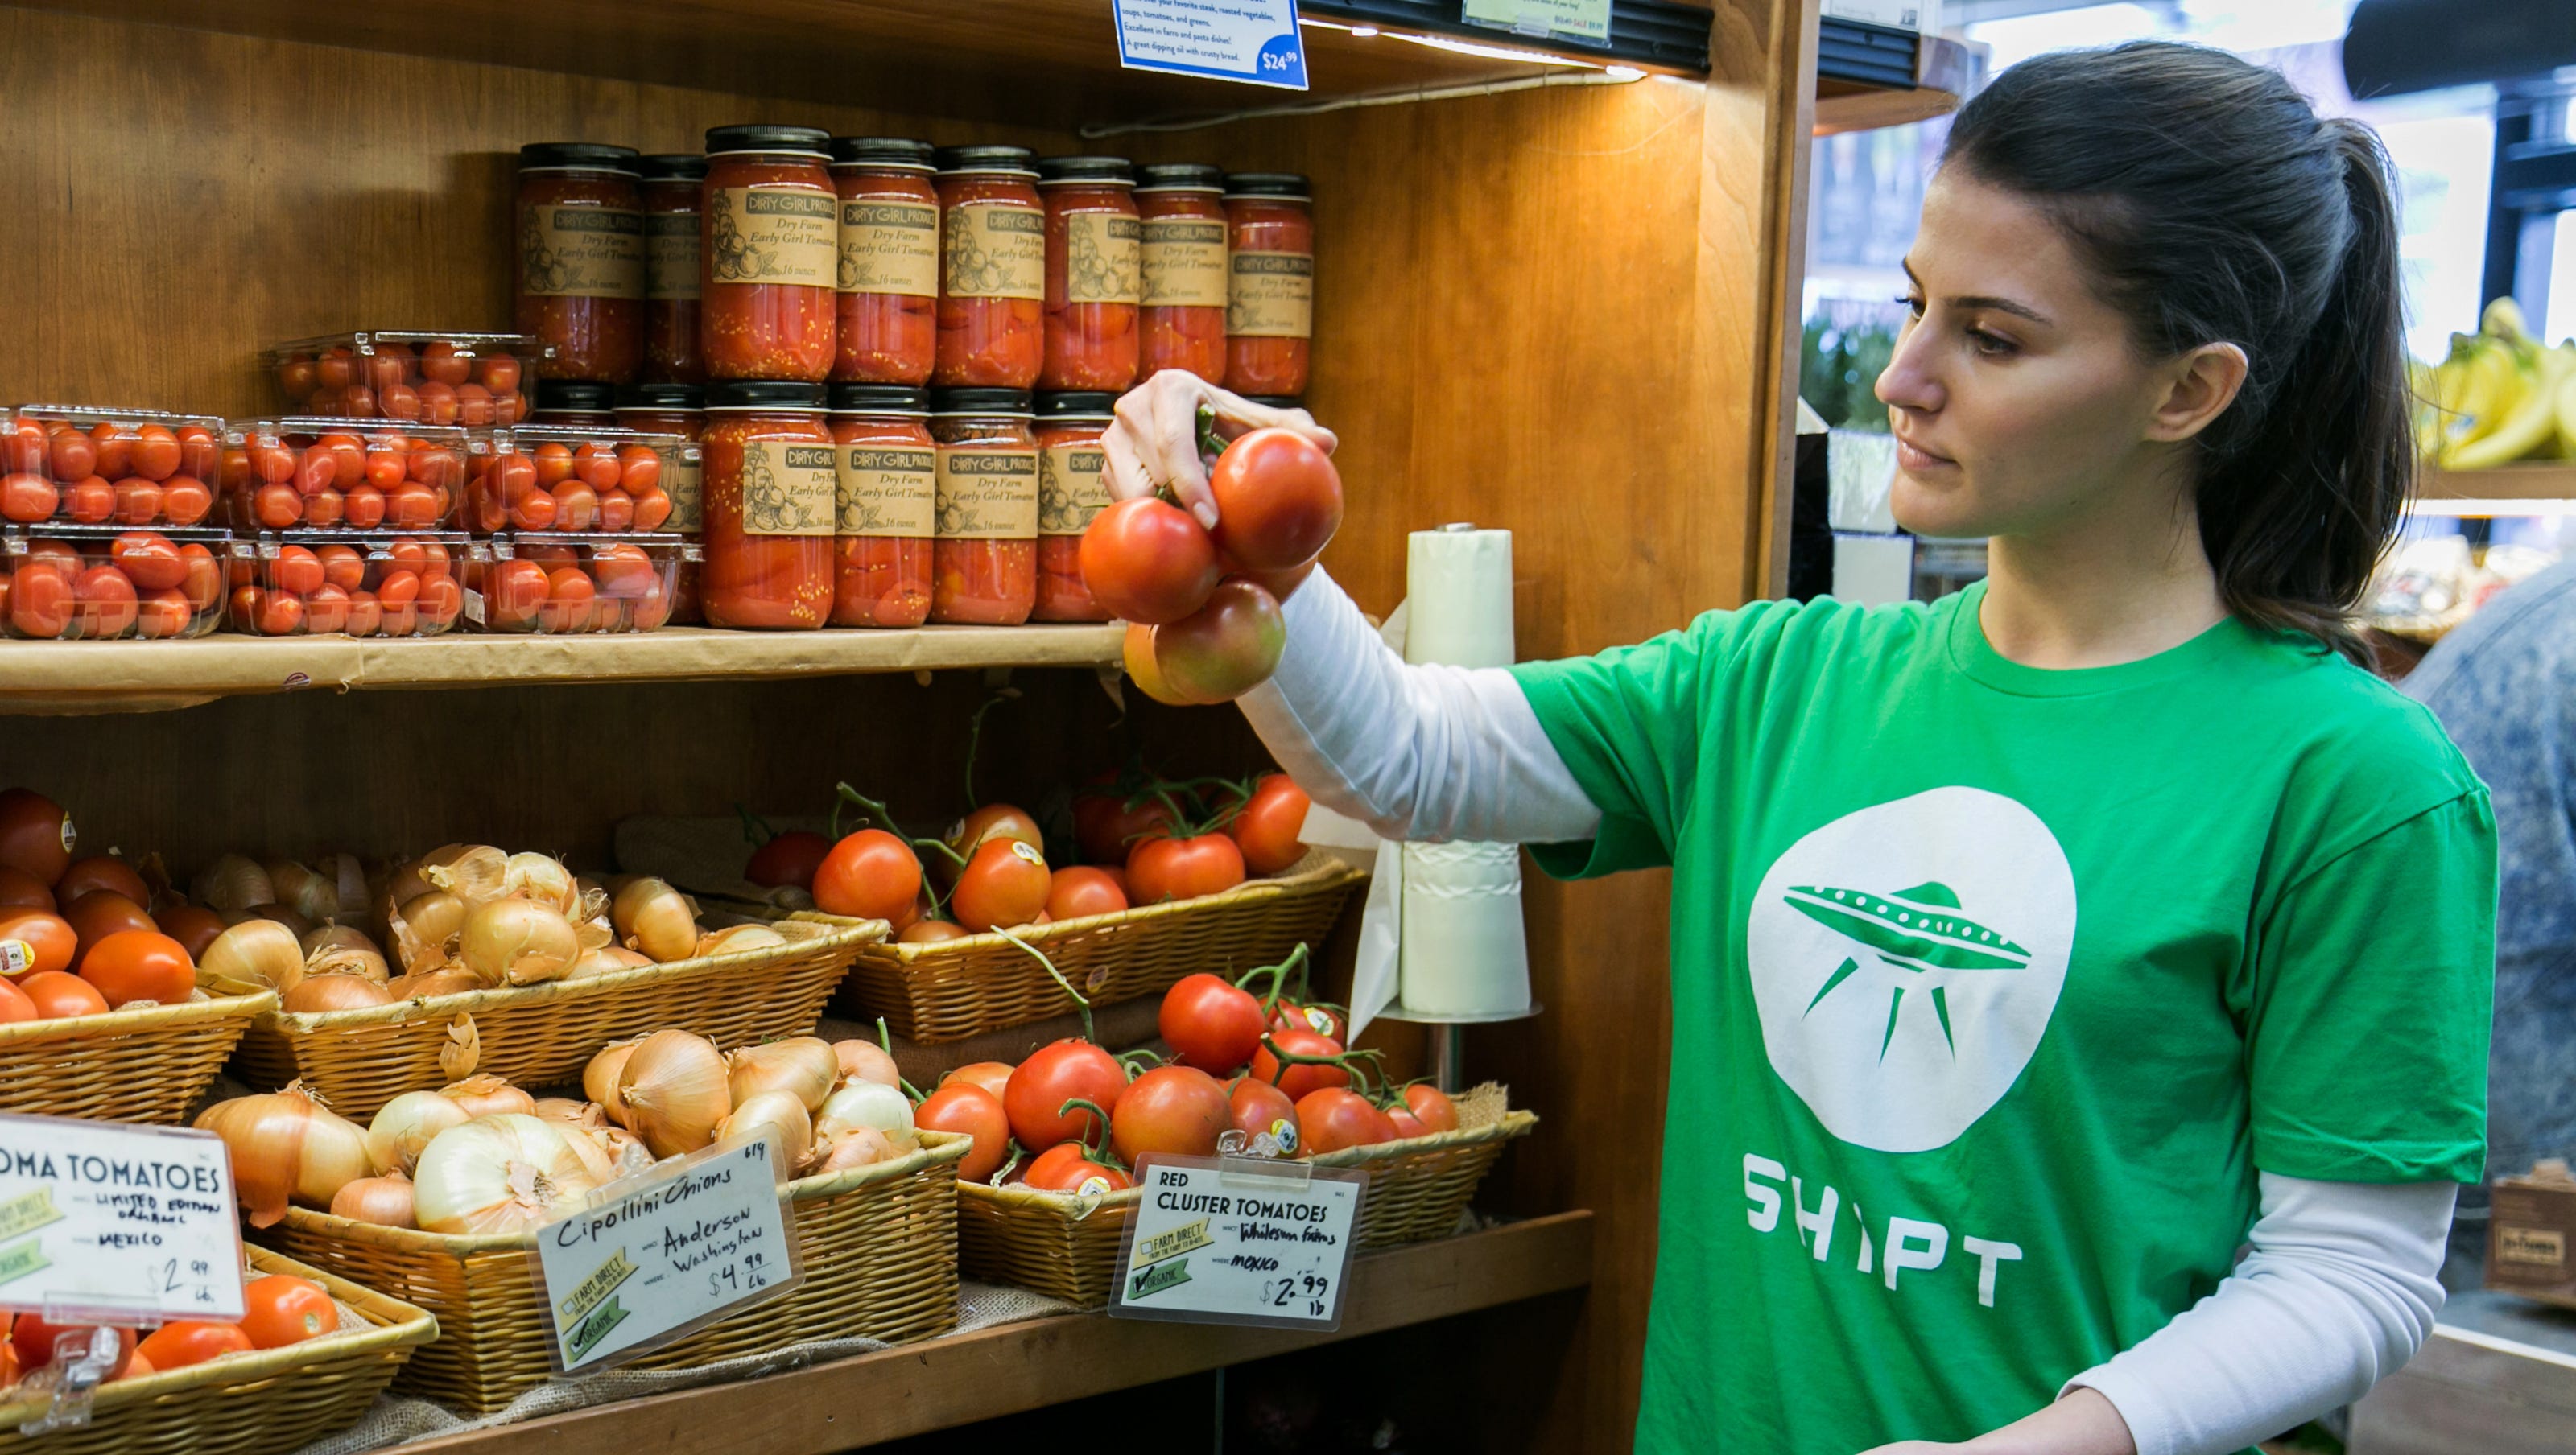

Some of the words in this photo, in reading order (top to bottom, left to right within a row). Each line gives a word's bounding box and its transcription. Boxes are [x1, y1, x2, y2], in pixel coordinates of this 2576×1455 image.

[1176, 15, 1187, 23] and
[1199, 3, 1217, 14] steak,
[1219, 7, 1241, 16] roasted
[1242, 11, 1275, 23] vegetables,
[1124, 21, 1154, 33] Excellent
[1163, 27, 1179, 37] farro
[1180, 31, 1191, 39] and
[1193, 34, 1209, 43] pasta
[1127, 38, 1132, 46] A
[1133, 41, 1150, 50] great
[1151, 41, 1175, 56] dipping
[1186, 46, 1199, 55] with
[1201, 50, 1220, 61] crusty
[1220, 51, 1240, 61] bread.
[1262, 51, 1298, 71] $24.99
[749, 196, 778, 210] DIRTY
[780, 196, 811, 212] GIRL
[847, 207, 876, 221] DIRTY
[877, 207, 907, 223] GIRL
[776, 217, 797, 231] Dry
[799, 219, 823, 231] Farm
[750, 232, 779, 246] Early
[782, 233, 804, 244] Girl
[873, 229, 894, 241] Dry
[896, 230, 920, 241] Farm
[1014, 235, 1030, 249] Dry
[847, 243, 876, 256] Early
[878, 243, 900, 254] Girl
[991, 248, 1018, 261] Early
[1018, 250, 1034, 260] Girl
[782, 264, 793, 275] 16
[878, 274, 889, 285] 16
[789, 451, 813, 465] DIRTY
[814, 451, 832, 466] GIRL
[853, 452, 881, 468] DIRTY
[883, 452, 912, 468] GIRL
[952, 456, 979, 472] DIRTY
[980, 456, 1010, 471] GIRL
[1071, 455, 1097, 469] DIRTY
[811, 471, 825, 486] Dry
[880, 473, 900, 487] Dry
[902, 474, 923, 484] Farm
[977, 477, 997, 491] Dry
[1000, 477, 1022, 488] Farm
[790, 484, 813, 499] Early
[815, 485, 828, 497] Girl
[854, 486, 882, 501] Early
[885, 487, 906, 498] Girl
[953, 491, 980, 504] Early
[983, 491, 1004, 501] Girl
[1072, 488, 1099, 501] Early
[886, 517, 895, 528] 16
[984, 521, 993, 530] 16
[67, 1154, 220, 1193] TOMATOES
[1159, 1172, 1189, 1187] RED
[557, 1194, 659, 1247] Cipollini
[664, 1169, 732, 1205] Onions
[1157, 1192, 1231, 1215] CLUSTER
[1236, 1198, 1328, 1223] TOMATOES
[1154, 1233, 1174, 1251] FARM
[1177, 1223, 1201, 1242] DIRECT
[1742, 1152, 2023, 1308] SHIPT
[99, 1233, 163, 1248] MEXICO
[1149, 1250, 1161, 1260] FROM
[1170, 1243, 1181, 1252] FARM
[573, 1280, 597, 1305] FARM
[595, 1255, 621, 1285] DIRECT
[1146, 1267, 1178, 1288] ORGANIC
[583, 1309, 614, 1344] ORGANIC
